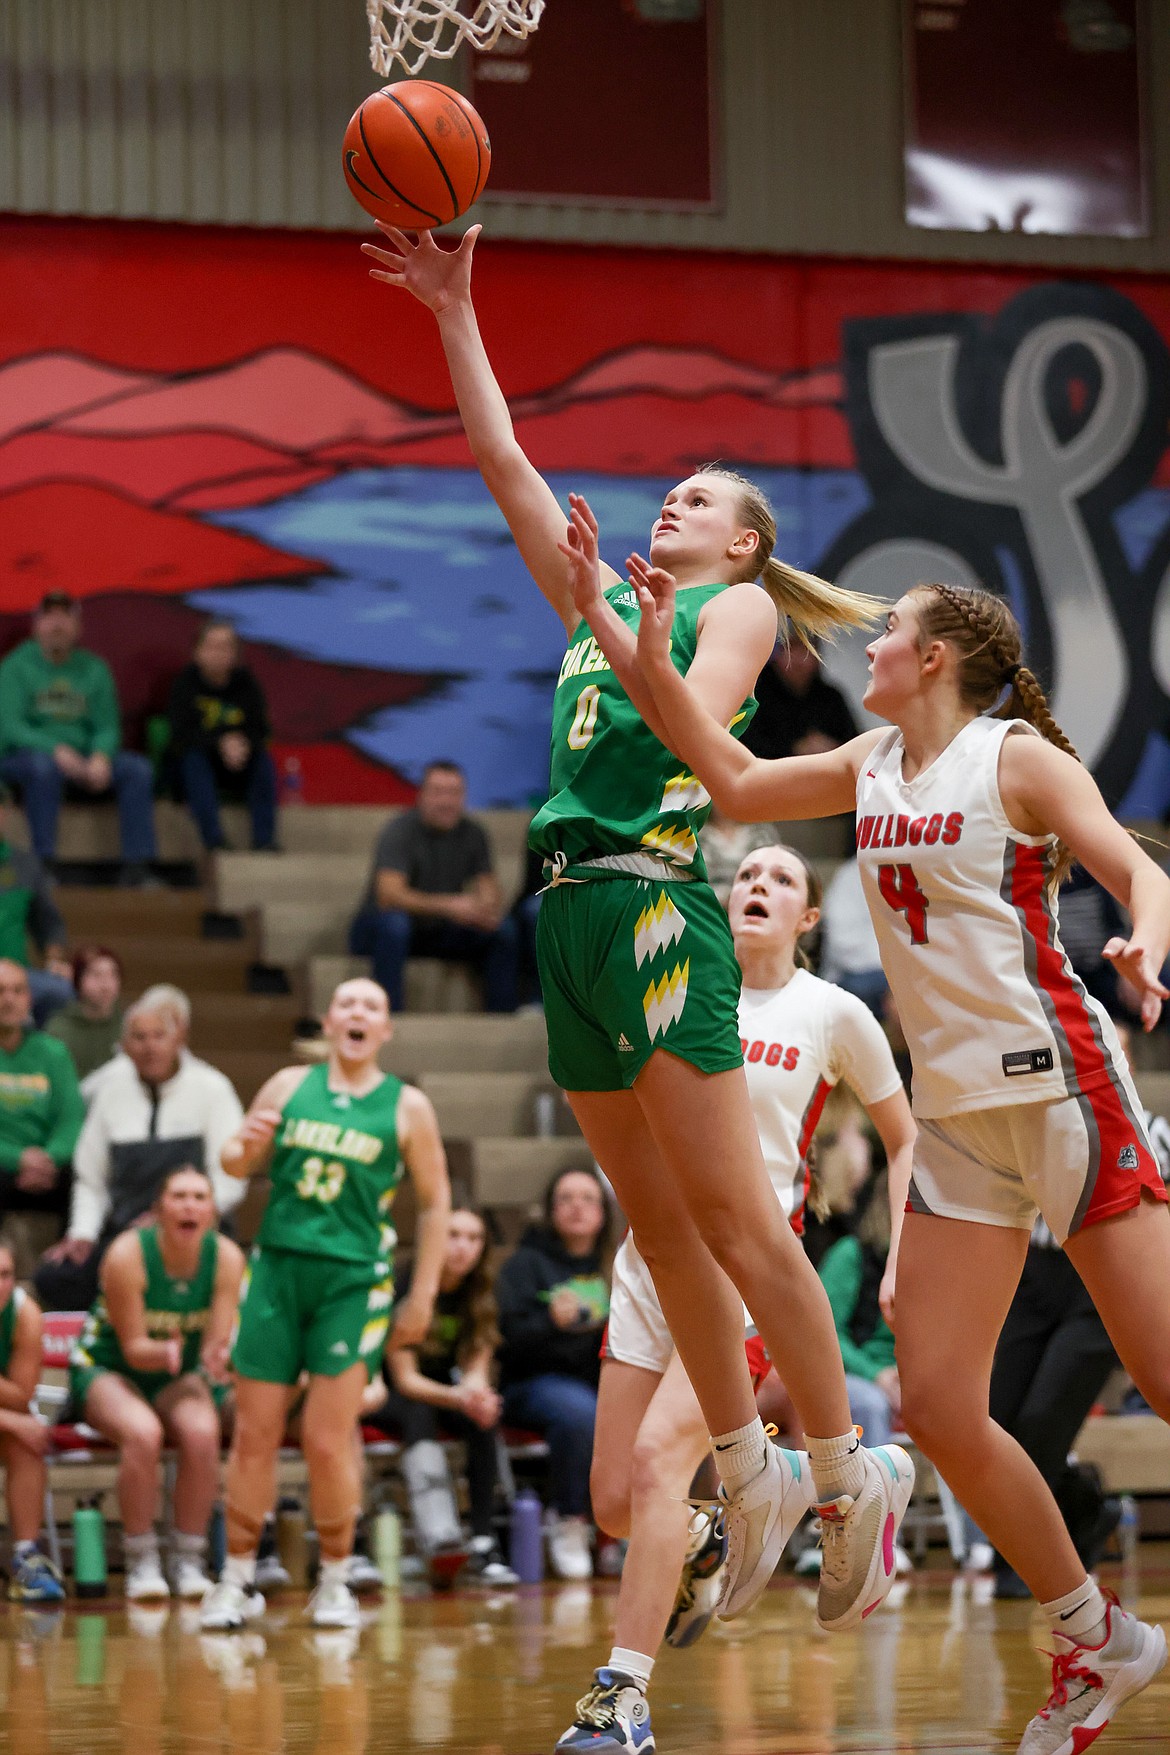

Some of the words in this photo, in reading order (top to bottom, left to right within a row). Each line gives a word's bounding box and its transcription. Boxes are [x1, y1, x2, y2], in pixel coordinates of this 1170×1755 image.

[613, 598, 640, 610] adidas
[567, 684, 601, 751] 0
[877, 863, 930, 946] 4
[282, 1118, 383, 1165] LAKELAND
[297, 1156, 347, 1204] 33
